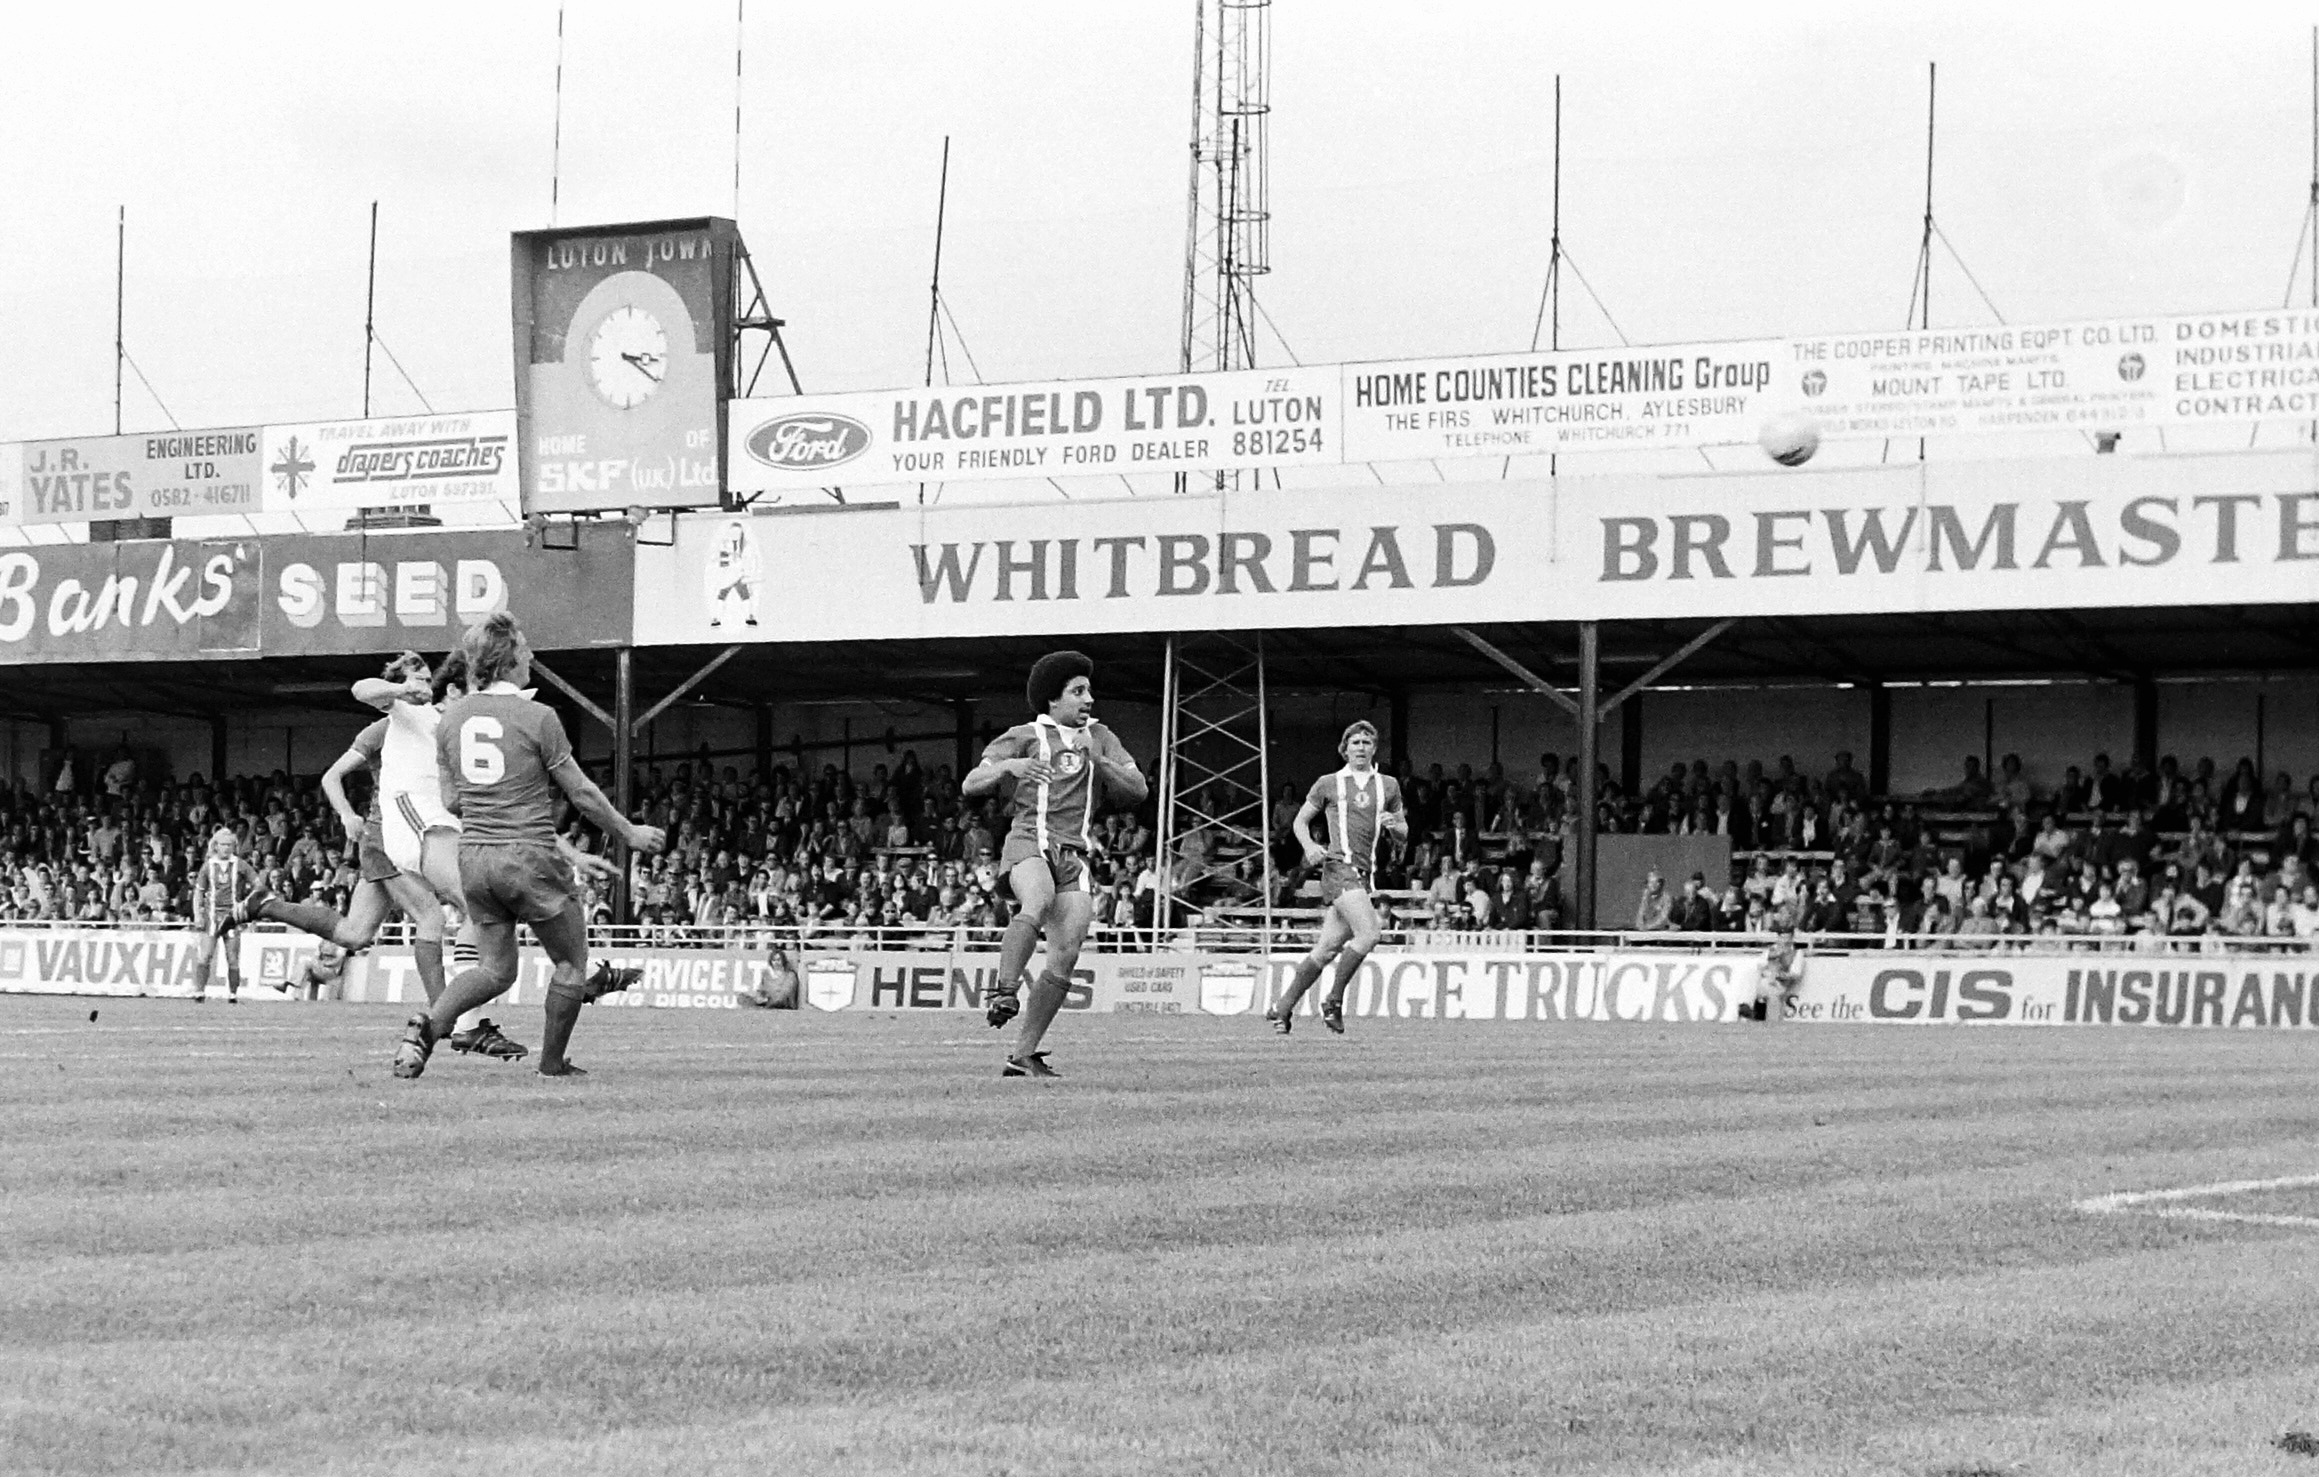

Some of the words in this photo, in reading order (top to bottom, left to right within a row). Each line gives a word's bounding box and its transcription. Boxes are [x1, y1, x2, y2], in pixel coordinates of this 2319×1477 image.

[1793, 342, 1827, 360] THE
[1834, 338, 1910, 359] COOPER
[1918, 332, 2013, 355] PRINTING
[2176, 341, 2319, 366] INDUSTRIA
[1356, 372, 1427, 408] HOME
[1435, 365, 1558, 403] COUNTIES
[1567, 358, 1684, 396] CLEANING
[1695, 356, 1771, 393] Group
[1872, 376, 1942, 396] MOUNT
[1957, 373, 2010, 392] TAPE
[891, 385, 1102, 442] HACFIELD
[1124, 384, 1215, 431] LTD.
[1233, 395, 1322, 425] LUTON
[1386, 413, 1420, 431] THE
[1642, 396, 1747, 419] AYLESBURY
[318, 425, 376, 441] TRAVEL
[379, 421, 427, 438] AWAY
[431, 418, 472, 435] WITH
[538, 435, 587, 455] HOME
[685, 428, 711, 449] OF
[768, 421, 847, 461] Ford
[1233, 427, 1323, 456] 881254
[1445, 430, 1531, 447] TELEPHONE
[1557, 425, 1655, 442] WHITCHURCH
[30, 448, 89, 473] J.R.
[147, 433, 257, 460] ENGINEERING
[336, 446, 414, 480] drapers
[416, 442, 506, 474] coaches
[892, 452, 944, 473] YOUR
[958, 447, 1047, 470] FRIENDLY
[1063, 444, 1117, 465] FORD
[1132, 440, 1209, 462] DEALER
[185, 462, 220, 480] LTD.
[537, 459, 628, 492] SKF
[30, 471, 133, 513] YATES
[390, 484, 437, 500] LUTON
[908, 521, 1497, 604] WHITBREAD
[277, 560, 507, 626] SEED
[460, 715, 505, 785] 6
[1125, 982, 1147, 993] USED
[1486, 961, 1732, 1021] TRUCKS
[1784, 995, 1823, 1020] See
[1832, 994, 1863, 1020] the
[1869, 969, 2014, 1021] CIS
[2020, 994, 2056, 1021] for
[2063, 968, 2319, 1028] INSURAN
